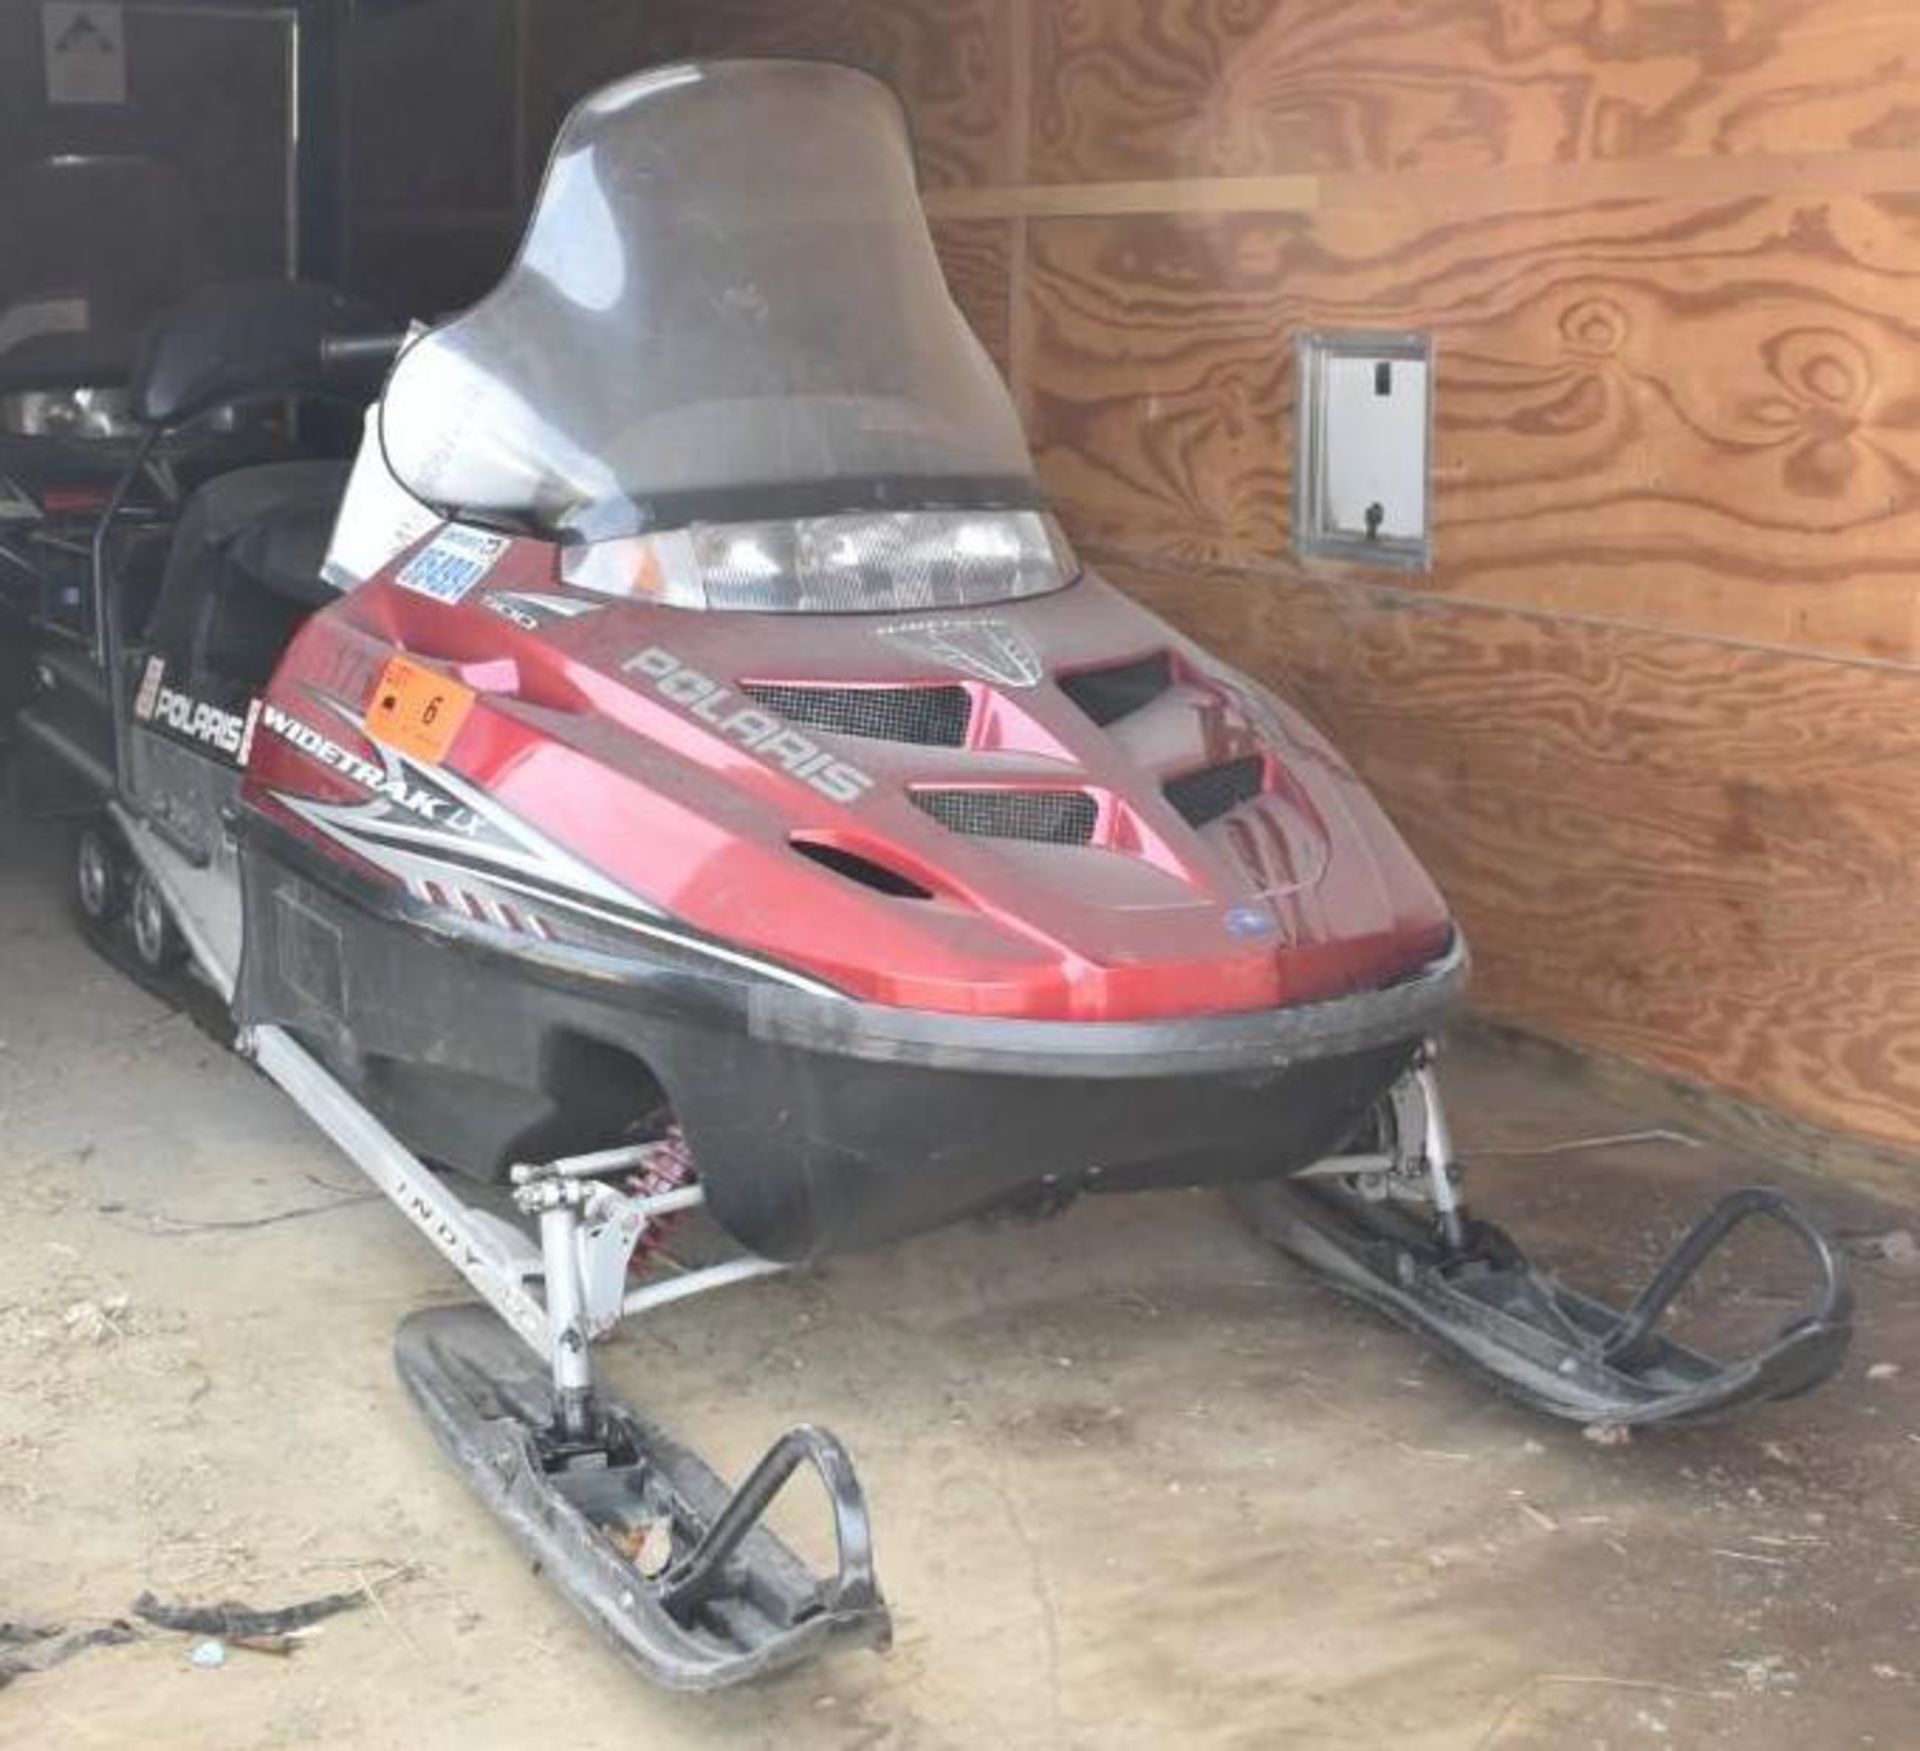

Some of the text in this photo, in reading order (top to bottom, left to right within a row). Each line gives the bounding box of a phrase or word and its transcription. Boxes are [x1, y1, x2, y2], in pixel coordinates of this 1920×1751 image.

[155, 687, 244, 753] POLARIS
[421, 696, 445, 725] 6
[620, 646, 875, 803] POLARIS
[264, 704, 450, 820] WIDETRAK
[397, 1181, 486, 1267] INDY
